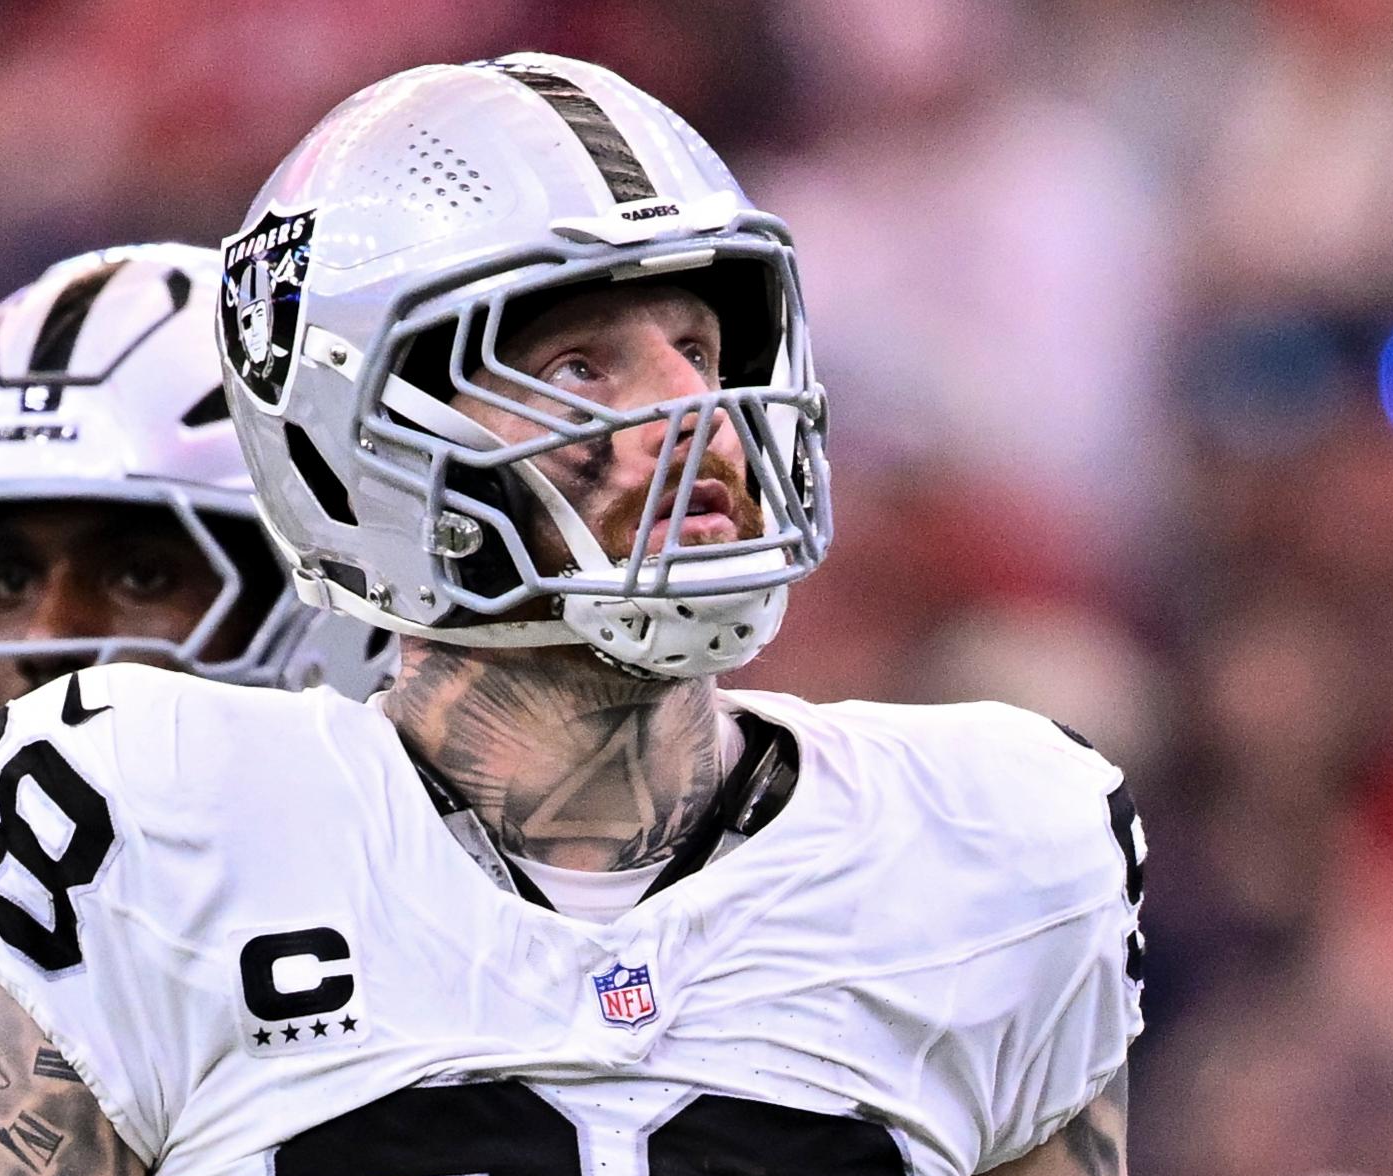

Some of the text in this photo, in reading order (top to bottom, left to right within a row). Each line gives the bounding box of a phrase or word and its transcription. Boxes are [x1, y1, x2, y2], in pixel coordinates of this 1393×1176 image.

[621, 205, 679, 221] RAIDERS
[240, 927, 354, 1021] C
[604, 988, 651, 1018] NFL
